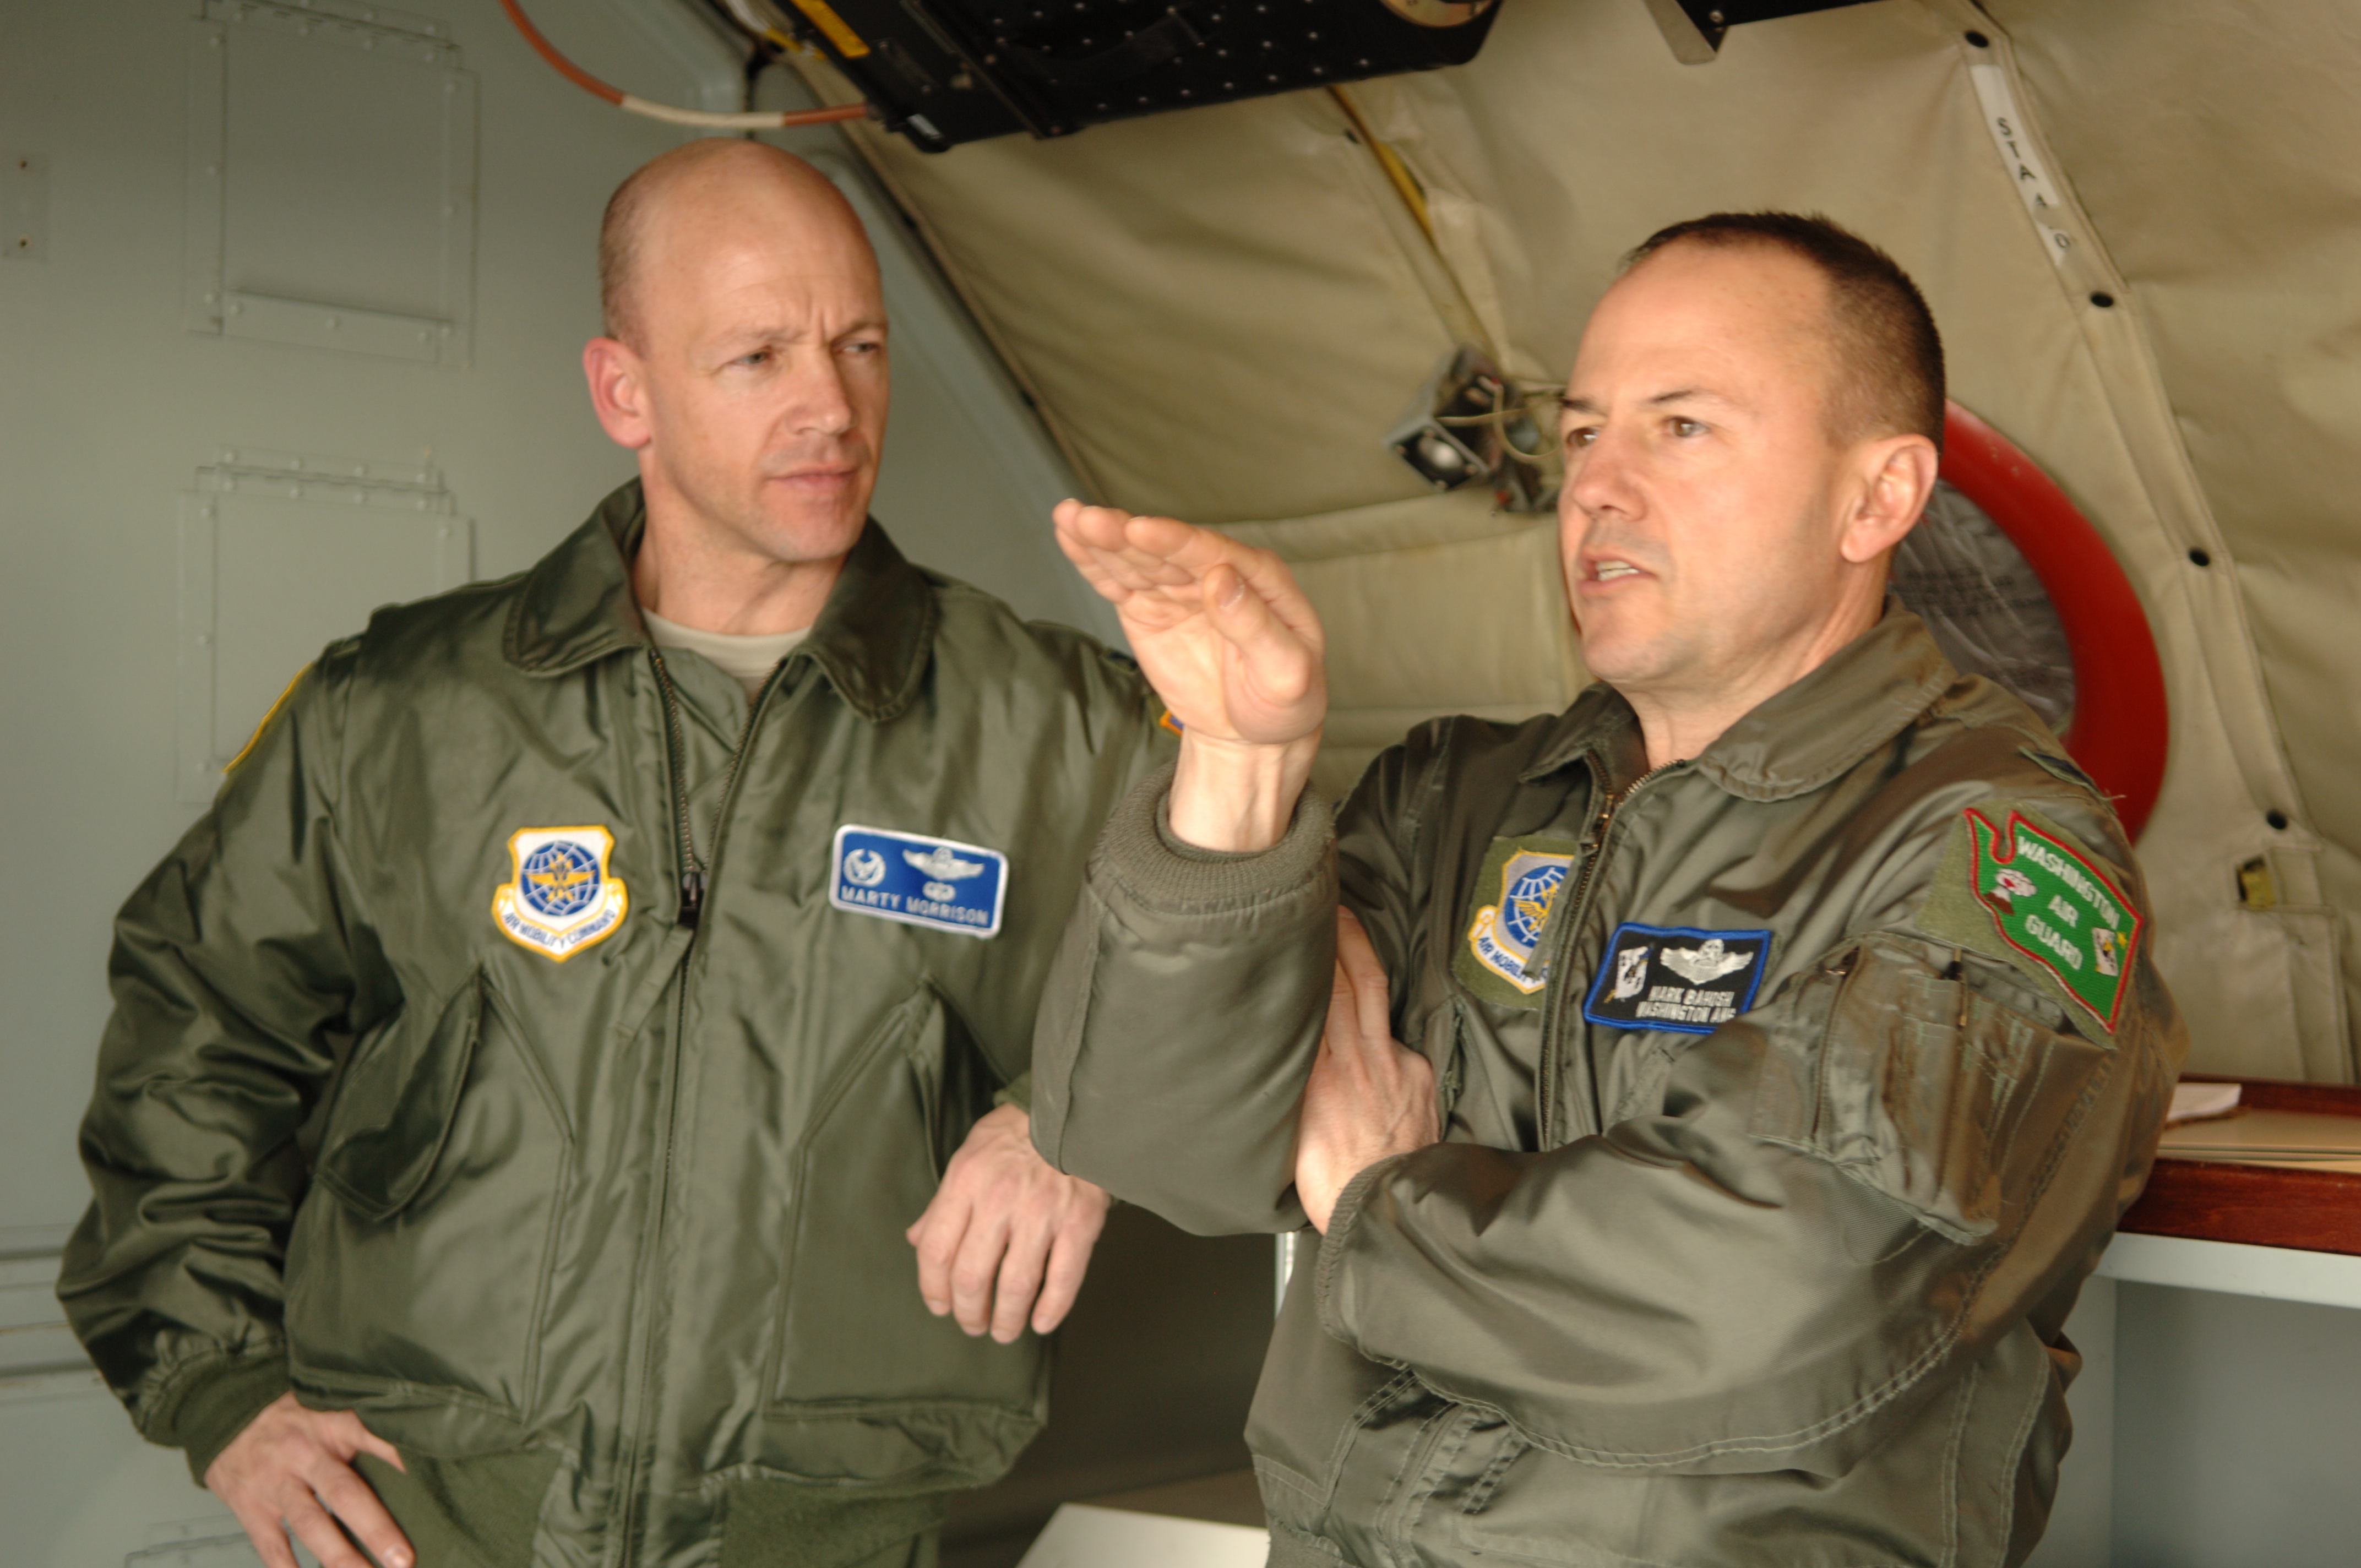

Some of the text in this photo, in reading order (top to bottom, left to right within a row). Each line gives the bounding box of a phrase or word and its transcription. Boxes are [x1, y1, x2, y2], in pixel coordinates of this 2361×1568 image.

[1996, 117, 2036, 181] STA
[2018, 836, 2120, 930] WASHINGTON
[841, 885, 989, 925] MARTY MORRISON
[2047, 894, 2079, 928] AIR
[519, 922, 565, 949] MOBILITY
[1478, 937, 1493, 957] AIR
[2025, 914, 2083, 970] GUARD
[1635, 1001, 1712, 1022] WASHINGTON
[1647, 986, 1685, 1003] MARK
